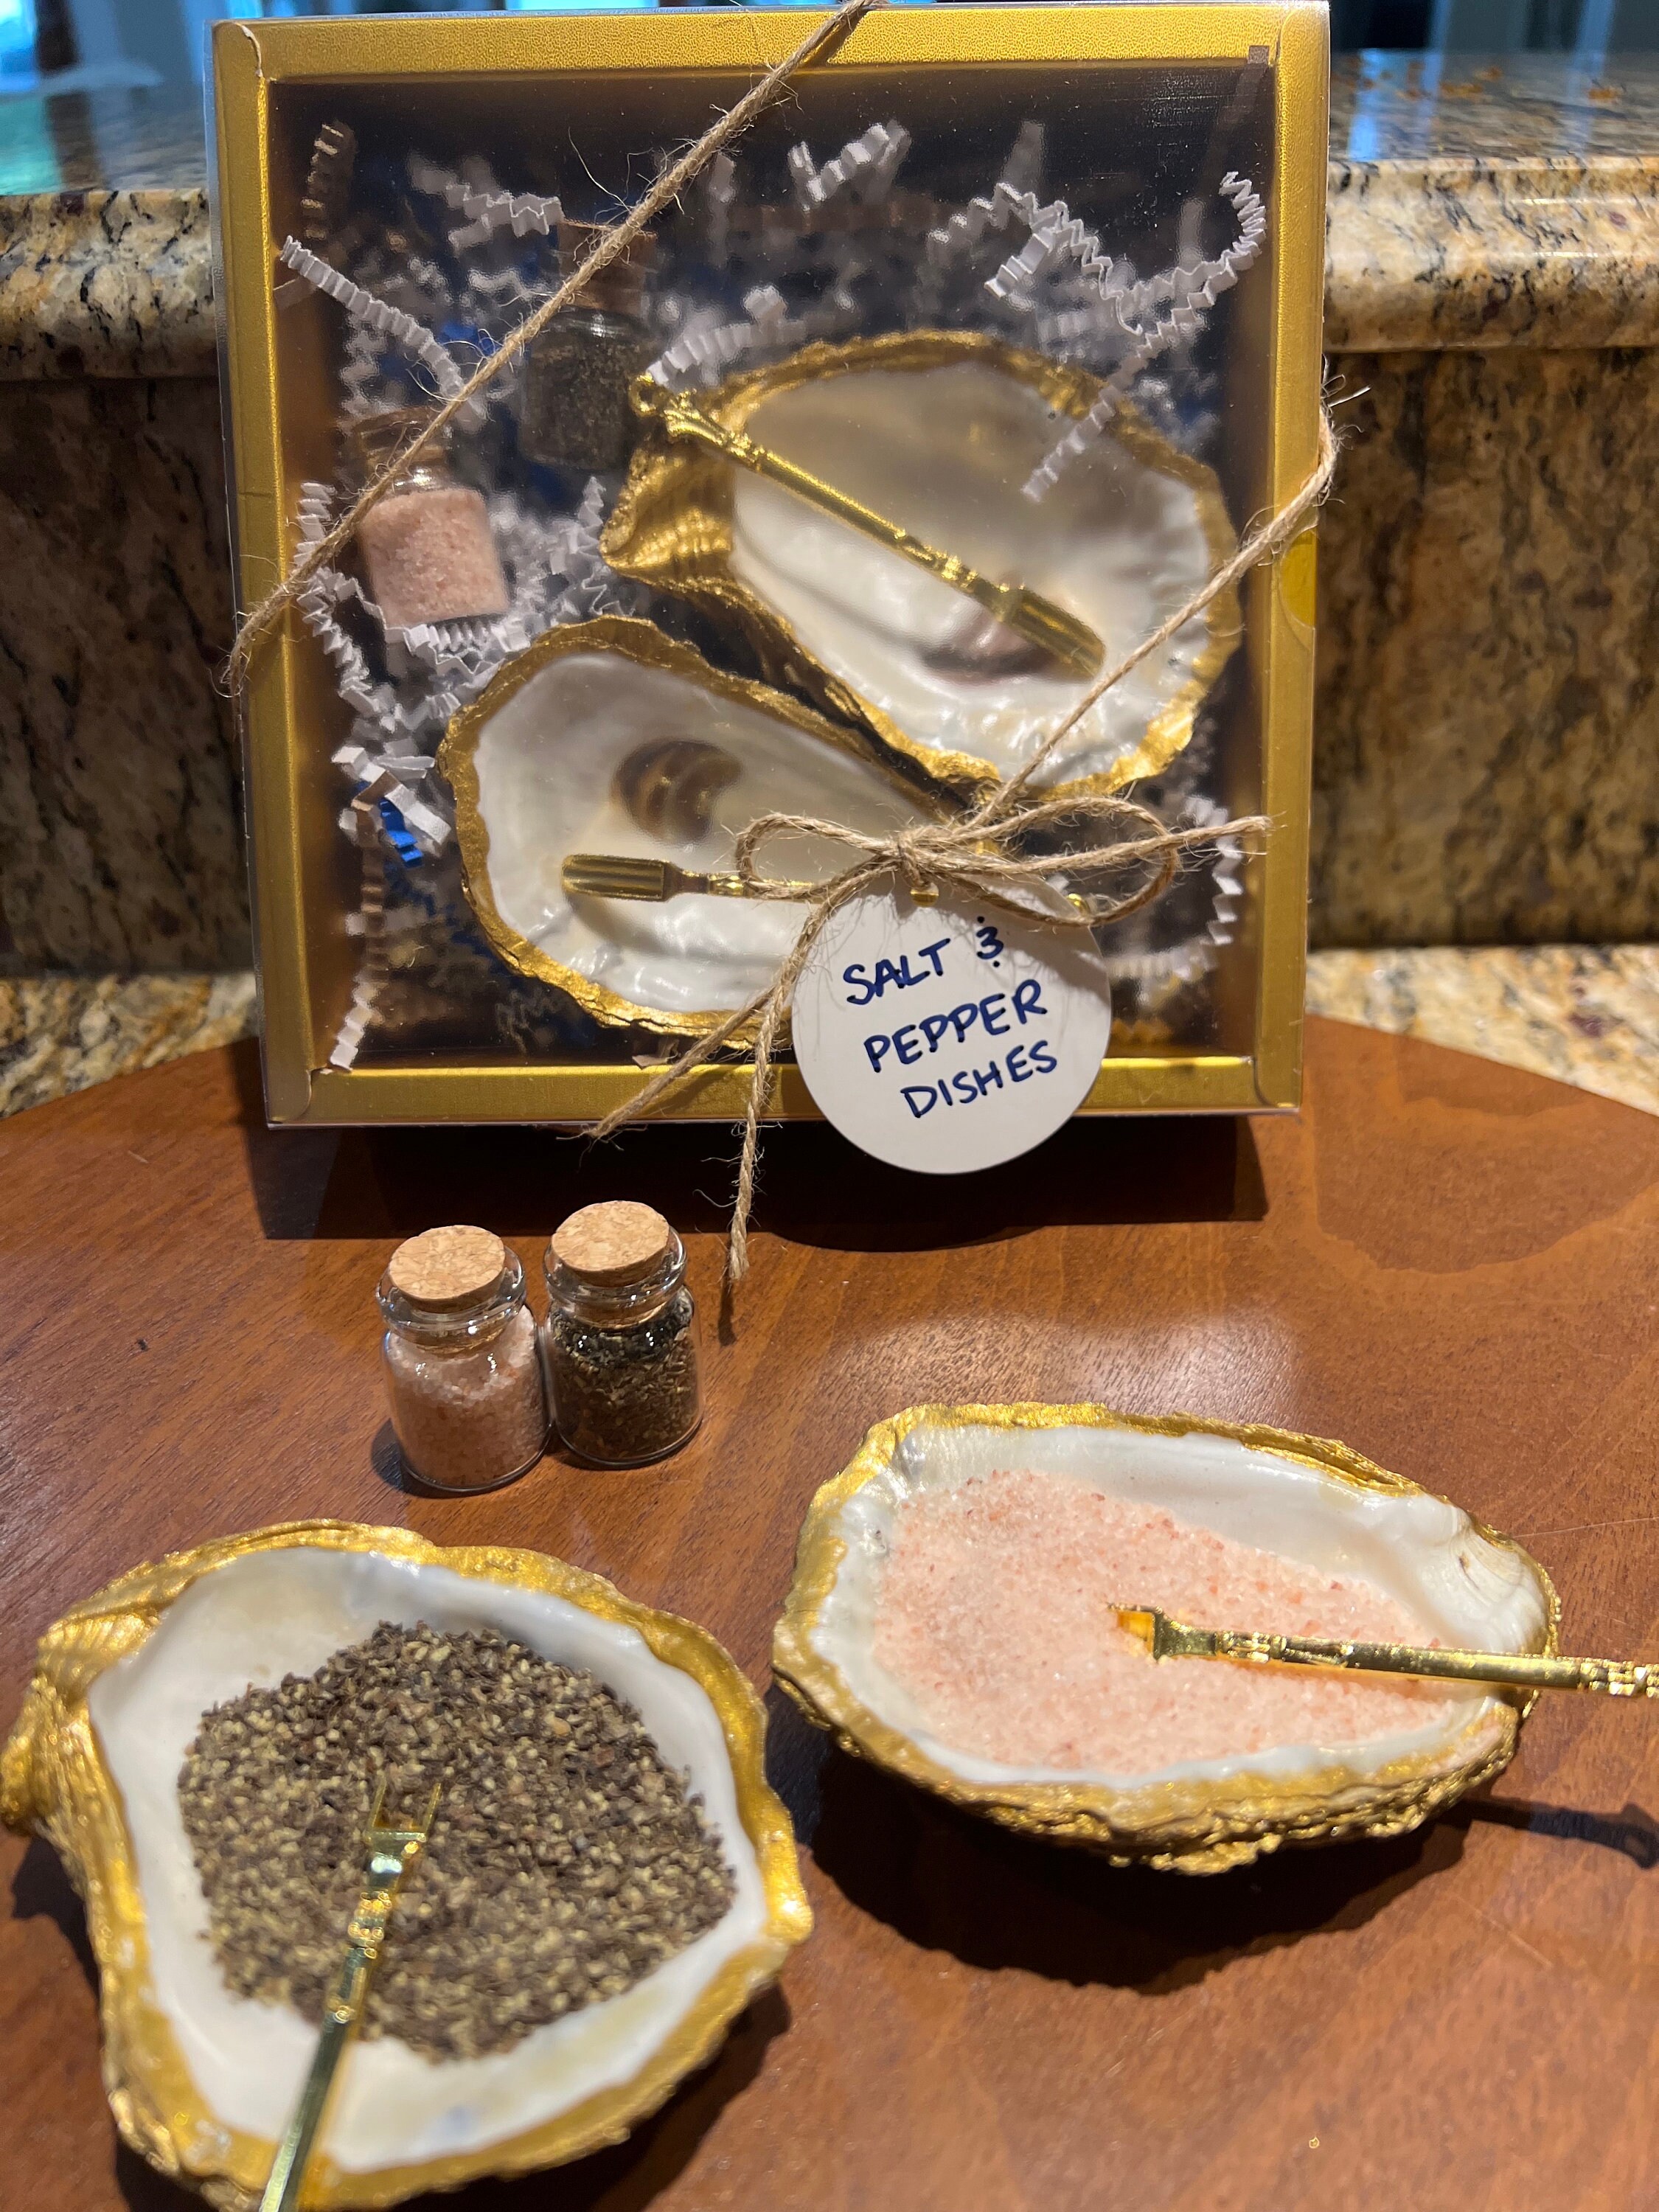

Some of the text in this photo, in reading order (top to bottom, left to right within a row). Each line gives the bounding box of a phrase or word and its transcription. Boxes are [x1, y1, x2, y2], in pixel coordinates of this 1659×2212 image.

[842, 937, 951, 1006] SALT
[863, 978, 1048, 1074] PEPPER
[900, 1040, 1057, 1119] DISHES
